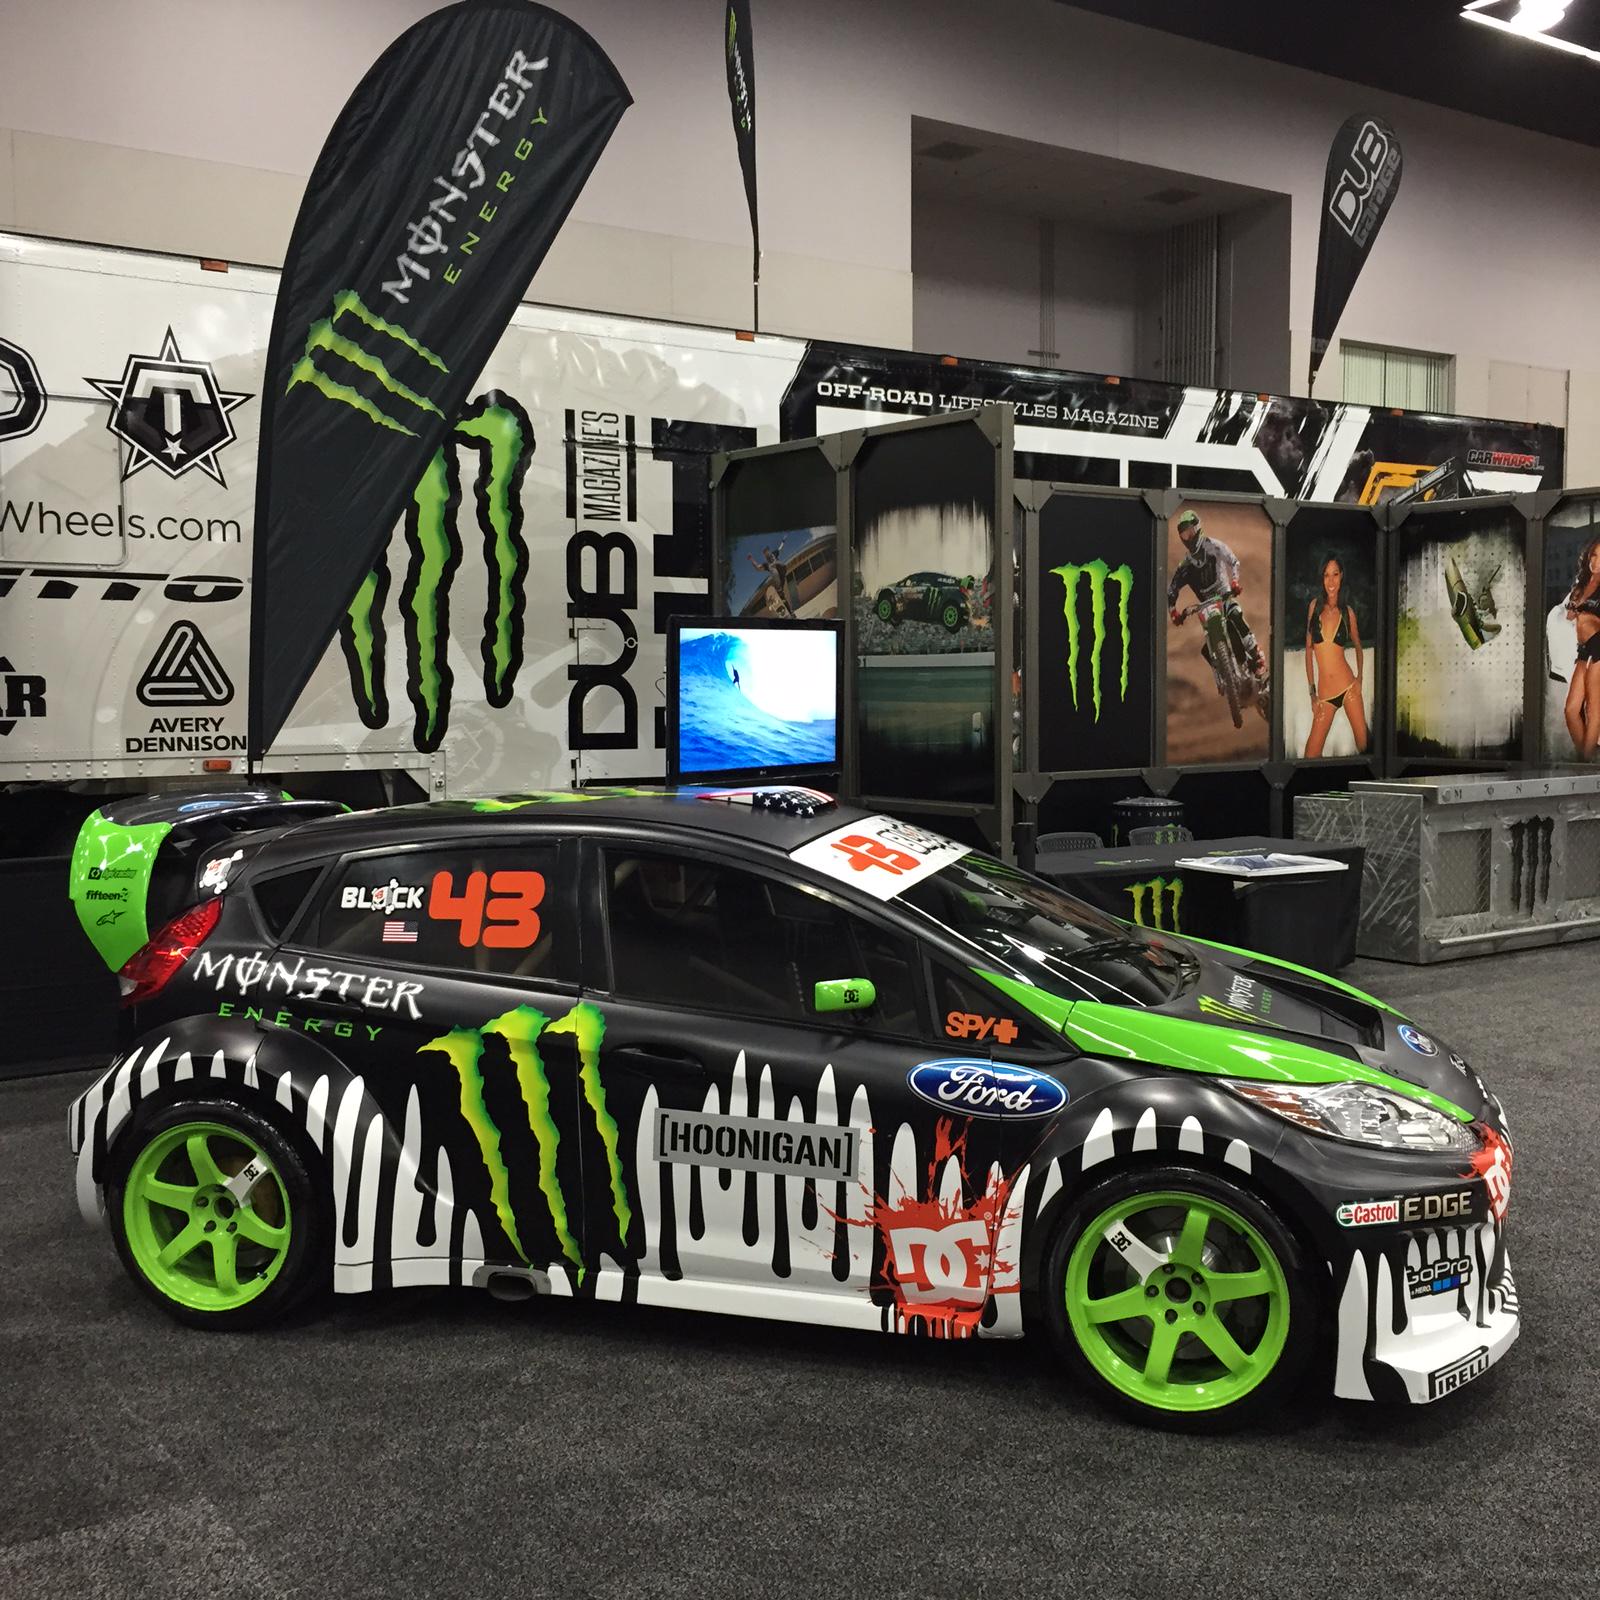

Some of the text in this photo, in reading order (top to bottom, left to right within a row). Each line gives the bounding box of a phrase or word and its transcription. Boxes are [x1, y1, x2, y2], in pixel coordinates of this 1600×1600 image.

[443, 107, 548, 285] ENERGY
[1329, 120, 1389, 237] DUB
[817, 381, 1159, 430] OFF-ROAD LIFEYLES MAGAZINE
[566, 409, 639, 751] DUB MAGAZINE'S
[125, 735, 247, 753] DENNISON
[149, 717, 225, 733] AVERY
[428, 871, 546, 949] 43
[218, 1002, 383, 1041] ENERGY
[937, 1065, 1037, 1111] Ford
[1354, 1191, 1473, 1224] Castrol EDGE
[1406, 1258, 1470, 1286] GoPro
[1427, 1345, 1490, 1401] PIRELLI
